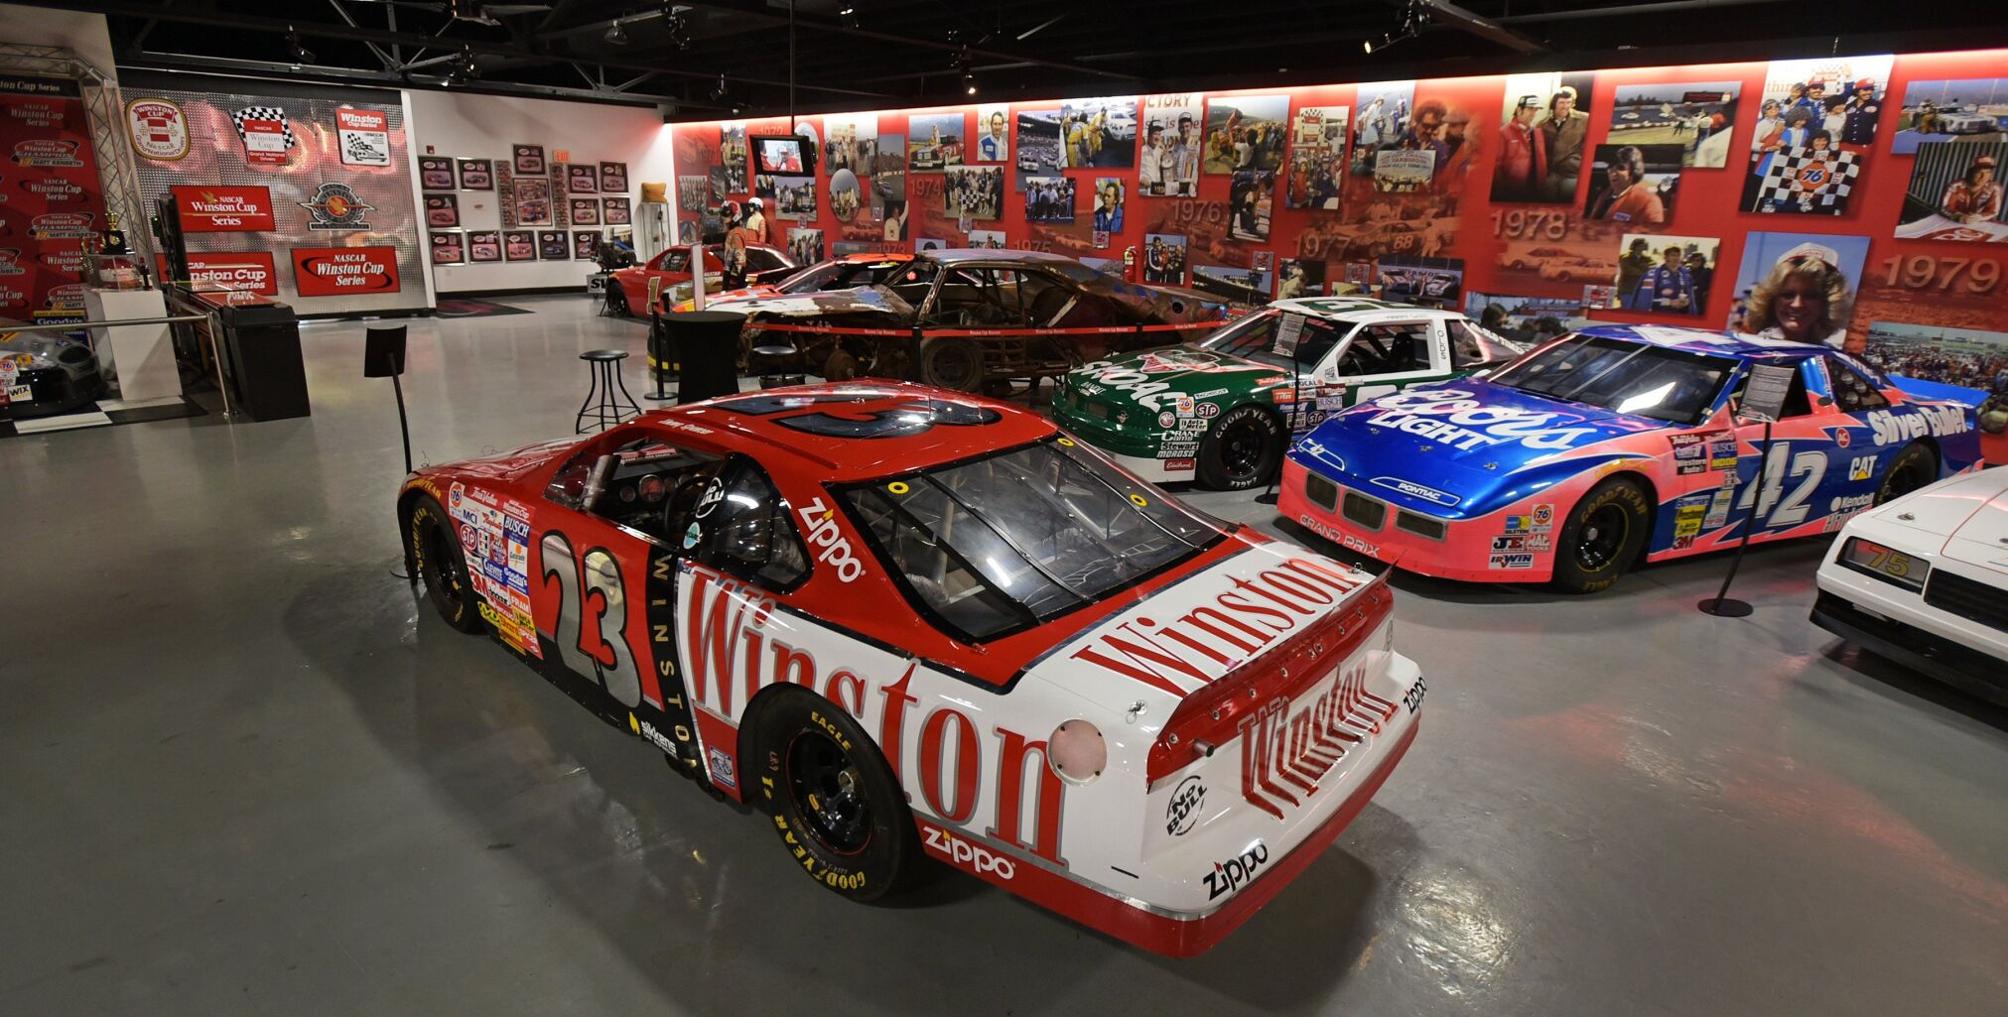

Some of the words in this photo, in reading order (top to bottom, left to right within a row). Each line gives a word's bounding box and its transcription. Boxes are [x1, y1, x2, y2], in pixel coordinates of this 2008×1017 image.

[17, 80, 36, 91] Cup
[137, 104, 173, 115] WINSTON
[341, 112, 382, 124] Winston
[251, 134, 281, 142] Winston
[258, 140, 273, 150] Cup
[1801, 170, 1824, 183] 76
[910, 178, 943, 198] 1974
[191, 201, 236, 212] Winston
[236, 200, 257, 215] Cup
[219, 196, 244, 204] NASCAR
[1171, 200, 1221, 222] 1976
[211, 215, 242, 225] Series
[1490, 208, 1568, 240] 1978
[1393, 235, 1414, 250] 68
[334, 254, 366, 262] NASCAR
[190, 270, 233, 280] nston
[234, 269, 267, 281] Cup
[317, 263, 360, 276] Winston
[362, 262, 384, 275] Cup
[1884, 254, 2000, 294] 1979
[235, 281, 266, 290] Series
[336, 276, 366, 286] Series
[9, 385, 29, 397] WIX
[1198, 404, 1217, 418] STP
[1309, 411, 1323, 424] STP
[1376, 389, 1598, 450] Coors
[1867, 407, 1930, 446] Silver
[1926, 405, 1968, 438] Bullet
[1366, 411, 1500, 451] LIGHT
[1160, 442, 1200, 450] Stewart
[1156, 450, 1196, 458] MOROSO
[1848, 455, 1878, 481] CAT
[1397, 482, 1442, 501] PONTIAC
[1738, 442, 1828, 528] 42
[450, 490, 461, 501] 76
[462, 508, 478, 525] MCI
[1536, 509, 1549, 519] 76
[504, 515, 530, 538] BUSCH
[1300, 513, 1341, 542] GRAND
[1342, 535, 1381, 559] PRIX
[1493, 536, 1524, 550] JE
[1672, 535, 1696, 550] 3M
[1490, 554, 1533, 568] IRWIN
[1867, 545, 1911, 578] 75
[540, 530, 642, 710] 23
[1069, 558, 1363, 700] Winston
[687, 564, 1070, 873] Winston
[811, 710, 852, 752] EAGLE
[1238, 661, 1399, 821] Winston
[1171, 783, 1197, 814] NO
[1166, 781, 1208, 836] BULL
[774, 814, 866, 890] GOODYEAR
